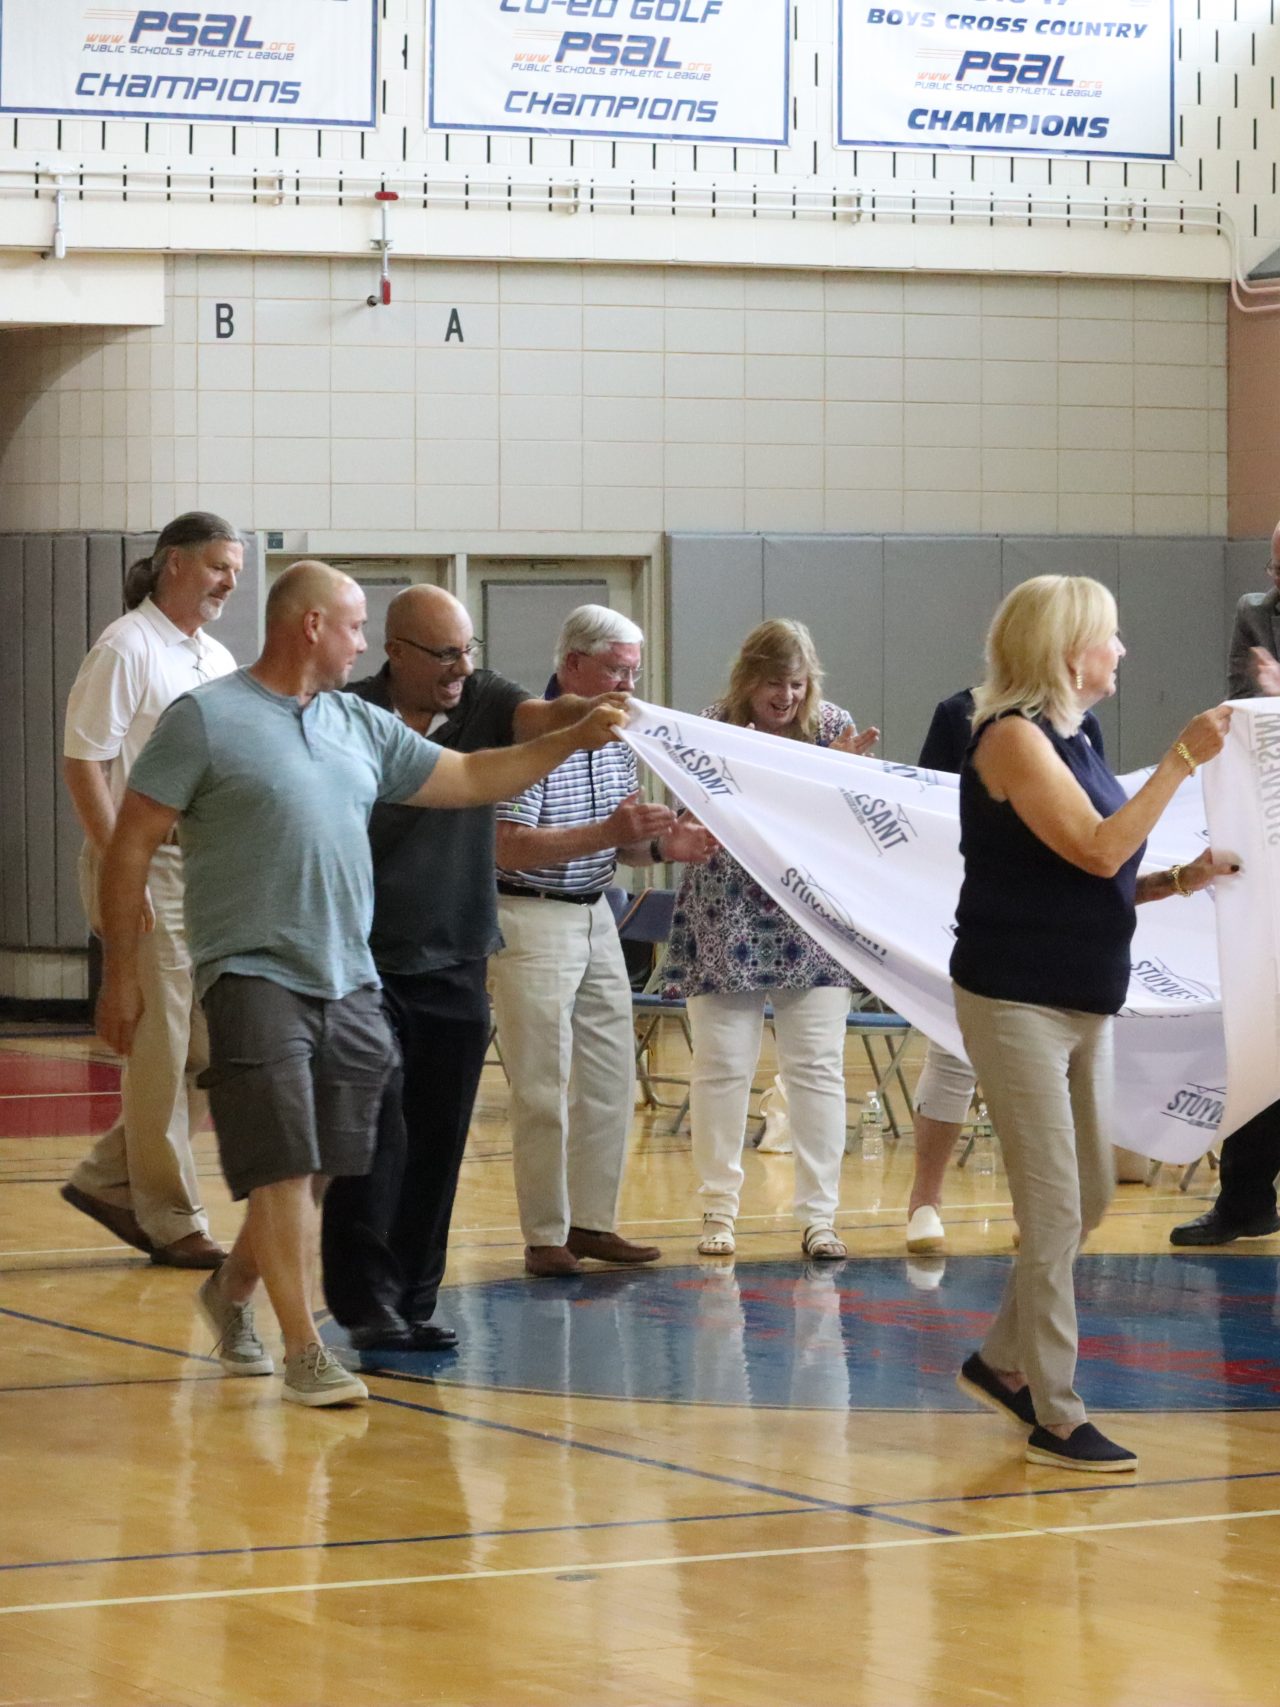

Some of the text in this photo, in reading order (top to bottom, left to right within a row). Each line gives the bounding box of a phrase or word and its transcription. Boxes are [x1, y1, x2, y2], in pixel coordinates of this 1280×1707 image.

[630, 0, 723, 23] GOLF
[867, 8, 1148, 39] BOYS CROSS COUNTRY
[82, 43, 126, 54] PUBLIC
[130, 46, 184, 56] SCHOOLS
[511, 62, 552, 72] PUBLIC
[555, 64, 606, 76] SCHOOLS
[914, 81, 952, 91] PUBLIC
[956, 83, 1004, 94] SCHOOLS
[907, 108, 1110, 139] CHAMPIONS
[215, 302, 234, 339] B
[444, 308, 464, 341] A
